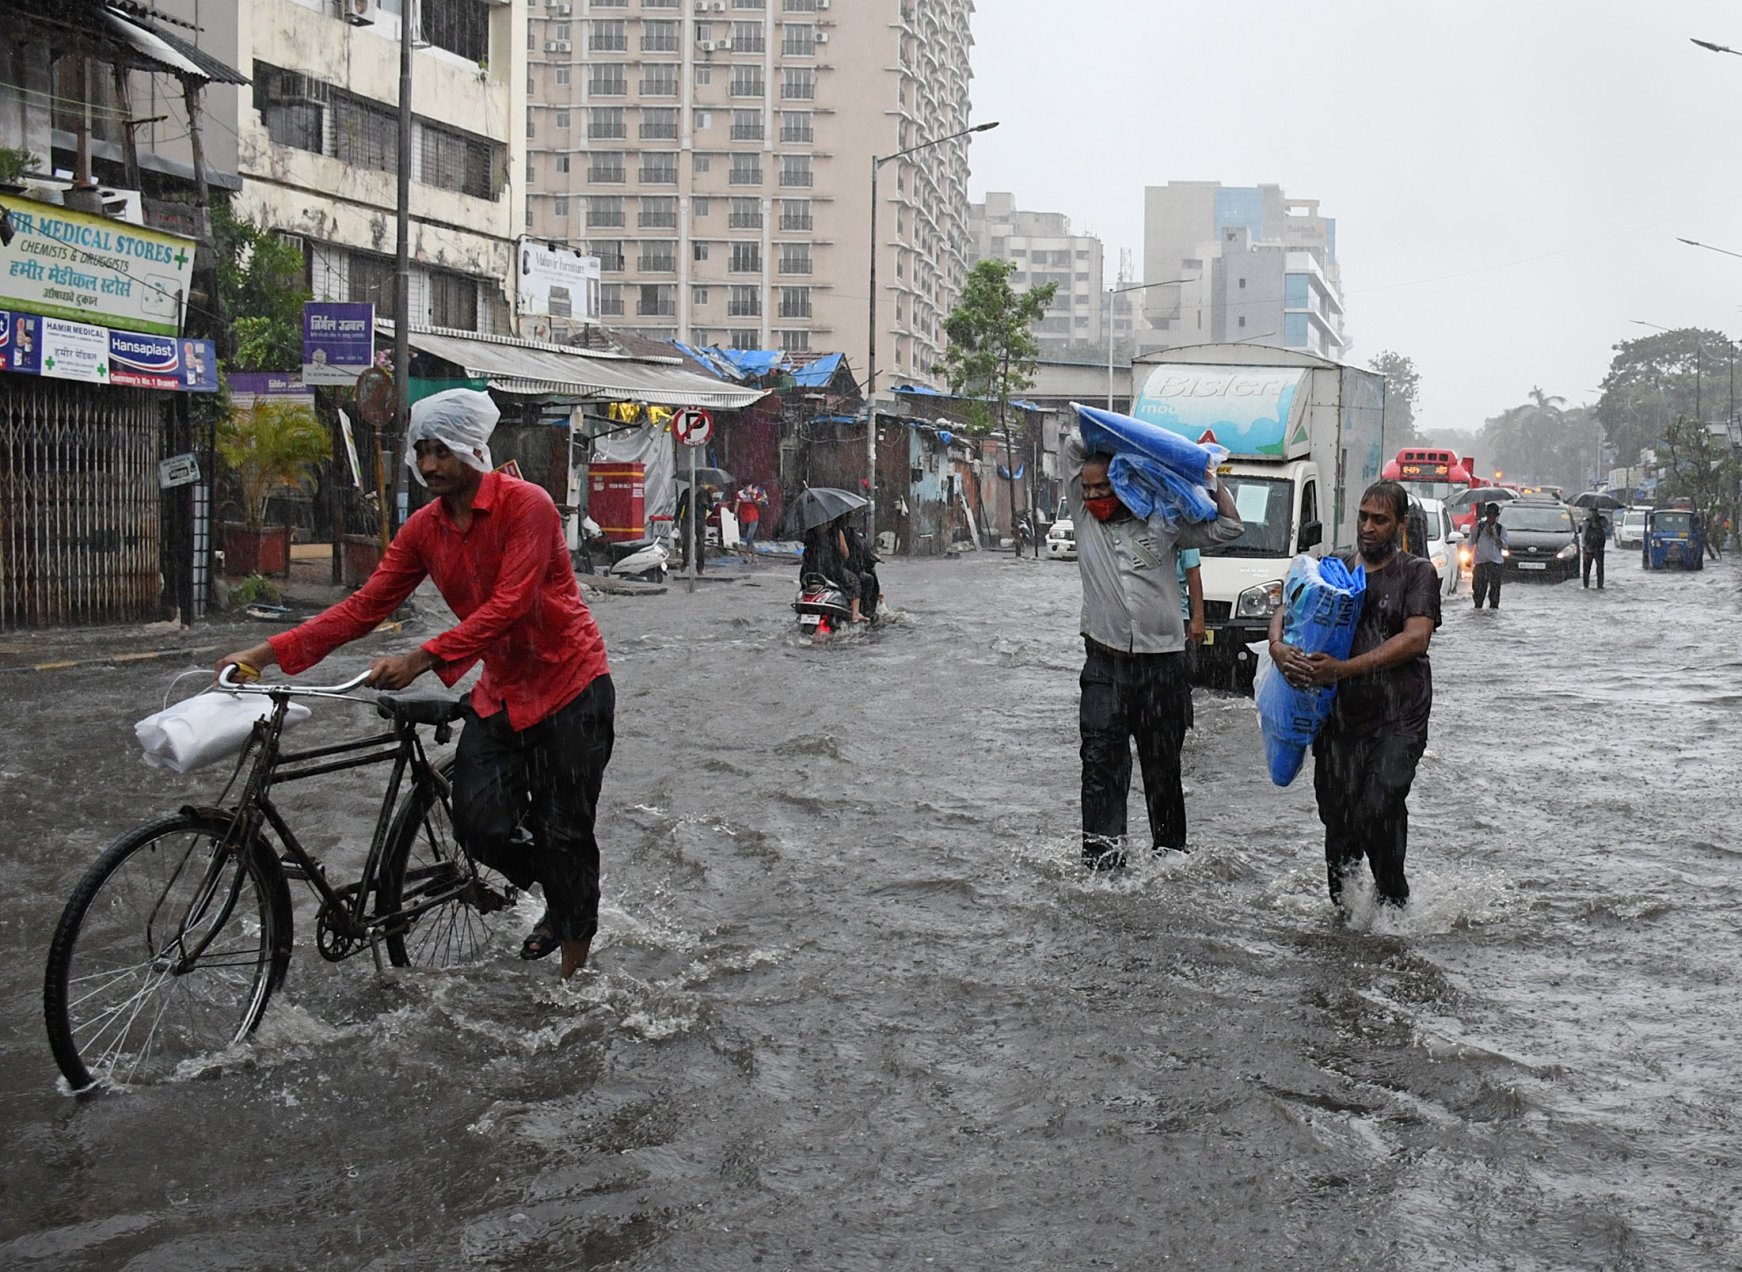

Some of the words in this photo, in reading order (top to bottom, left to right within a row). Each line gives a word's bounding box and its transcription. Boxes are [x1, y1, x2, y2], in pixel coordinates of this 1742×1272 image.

[20, 239, 67, 260] CHEMISTS
[69, 250, 77, 262] &
[80, 251, 130, 272] DRUGGISTS
[39, 217, 112, 251] MEDICAL
[116, 235, 173, 264] STORES
[9, 258, 44, 281] हमीर
[48, 264, 98, 291] मेडीकल
[100, 275, 133, 298] स्टोर्स
[46, 322, 72, 333] HAMIR
[73, 326, 104, 338] MEDICAL
[112, 338, 172, 357] Hansaplast
